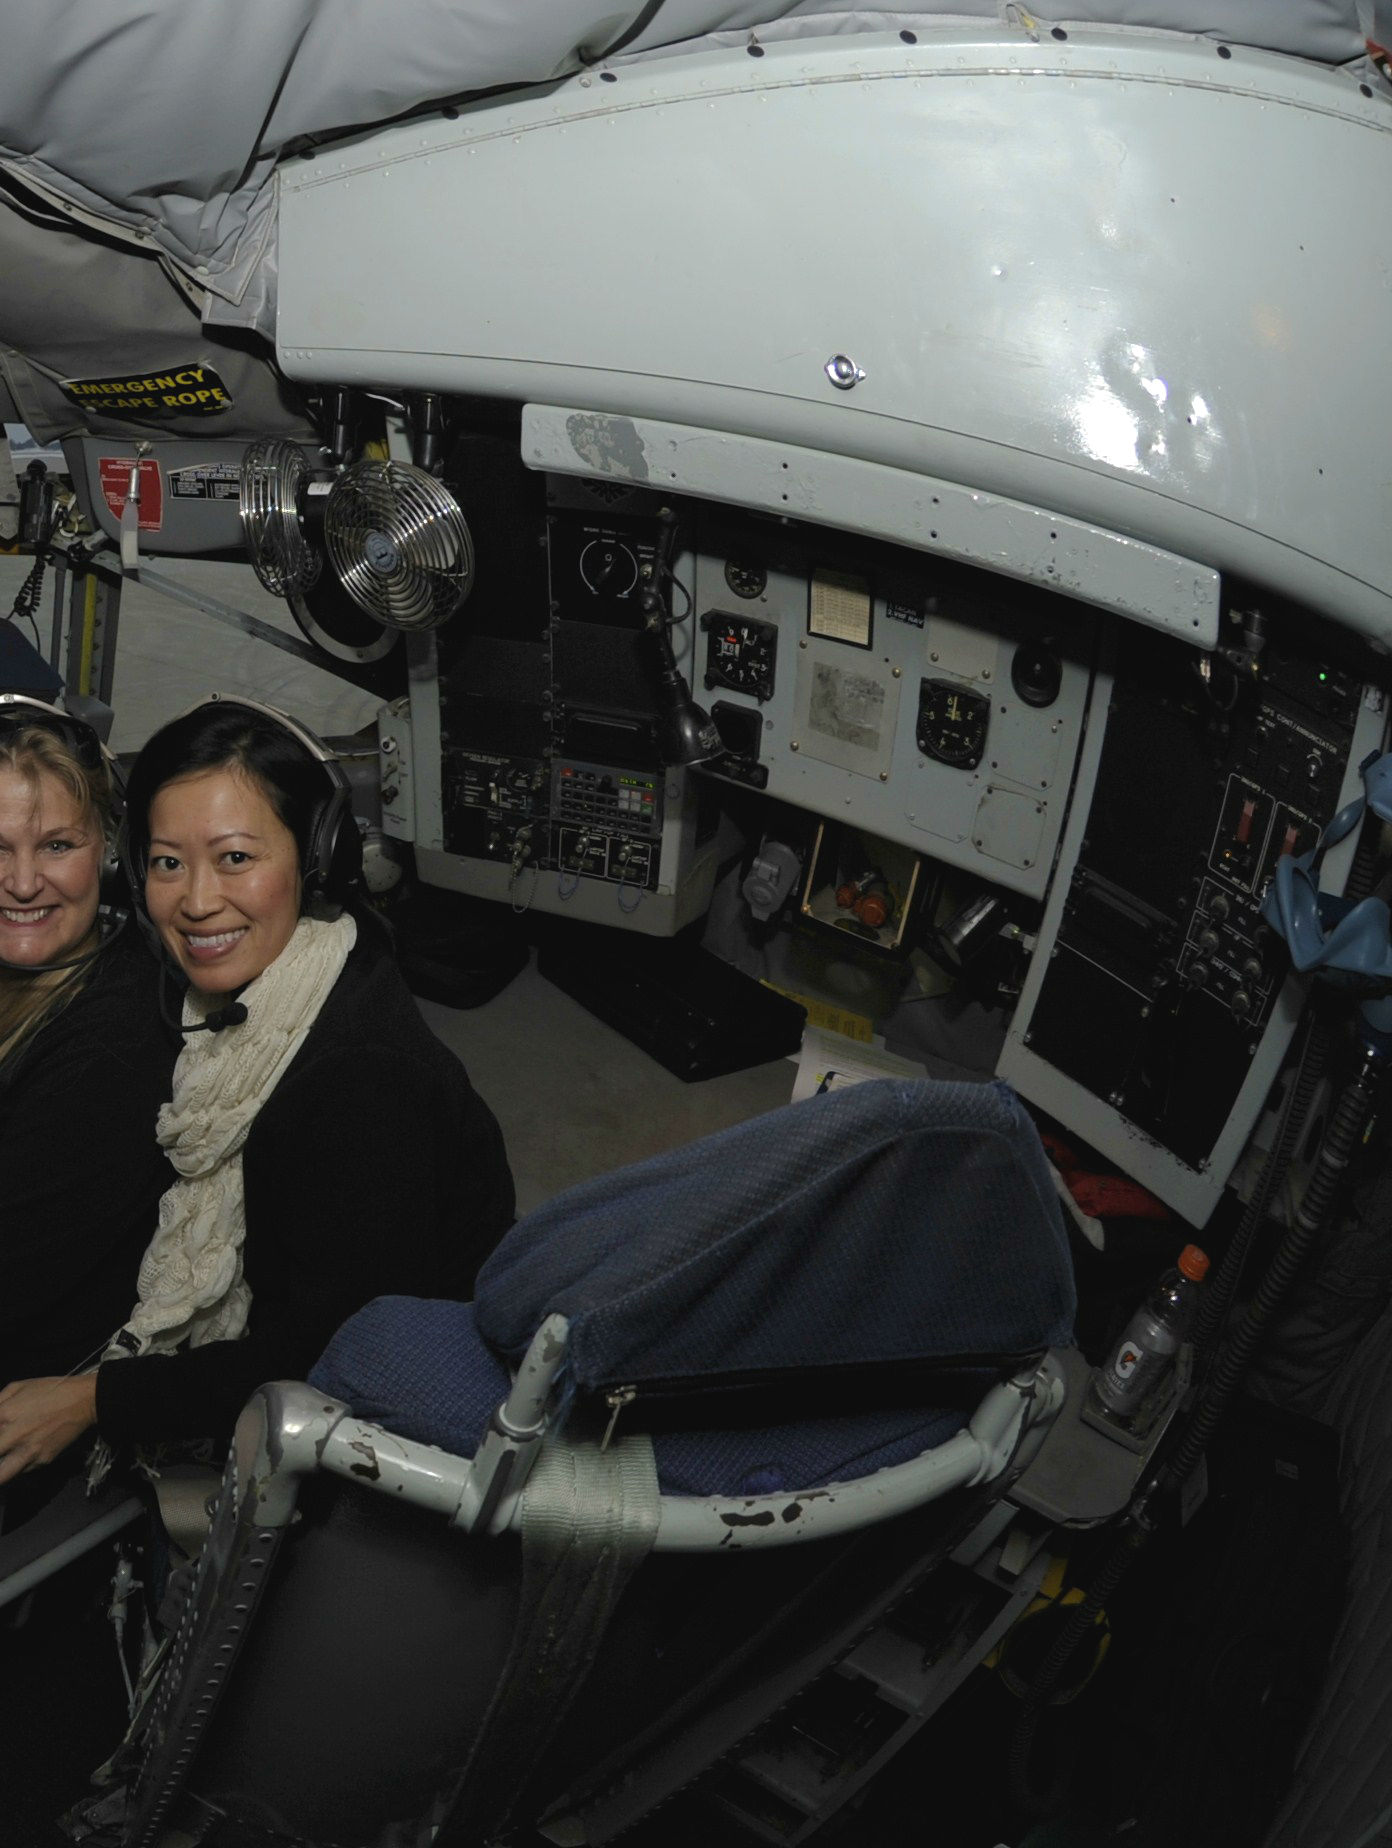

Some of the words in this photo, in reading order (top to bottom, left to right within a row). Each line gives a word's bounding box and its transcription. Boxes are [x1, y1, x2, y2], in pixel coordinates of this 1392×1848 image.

[68, 368, 206, 395] EMERGENCY
[162, 387, 226, 407] ROPE
[1115, 1340, 1144, 1379] G
